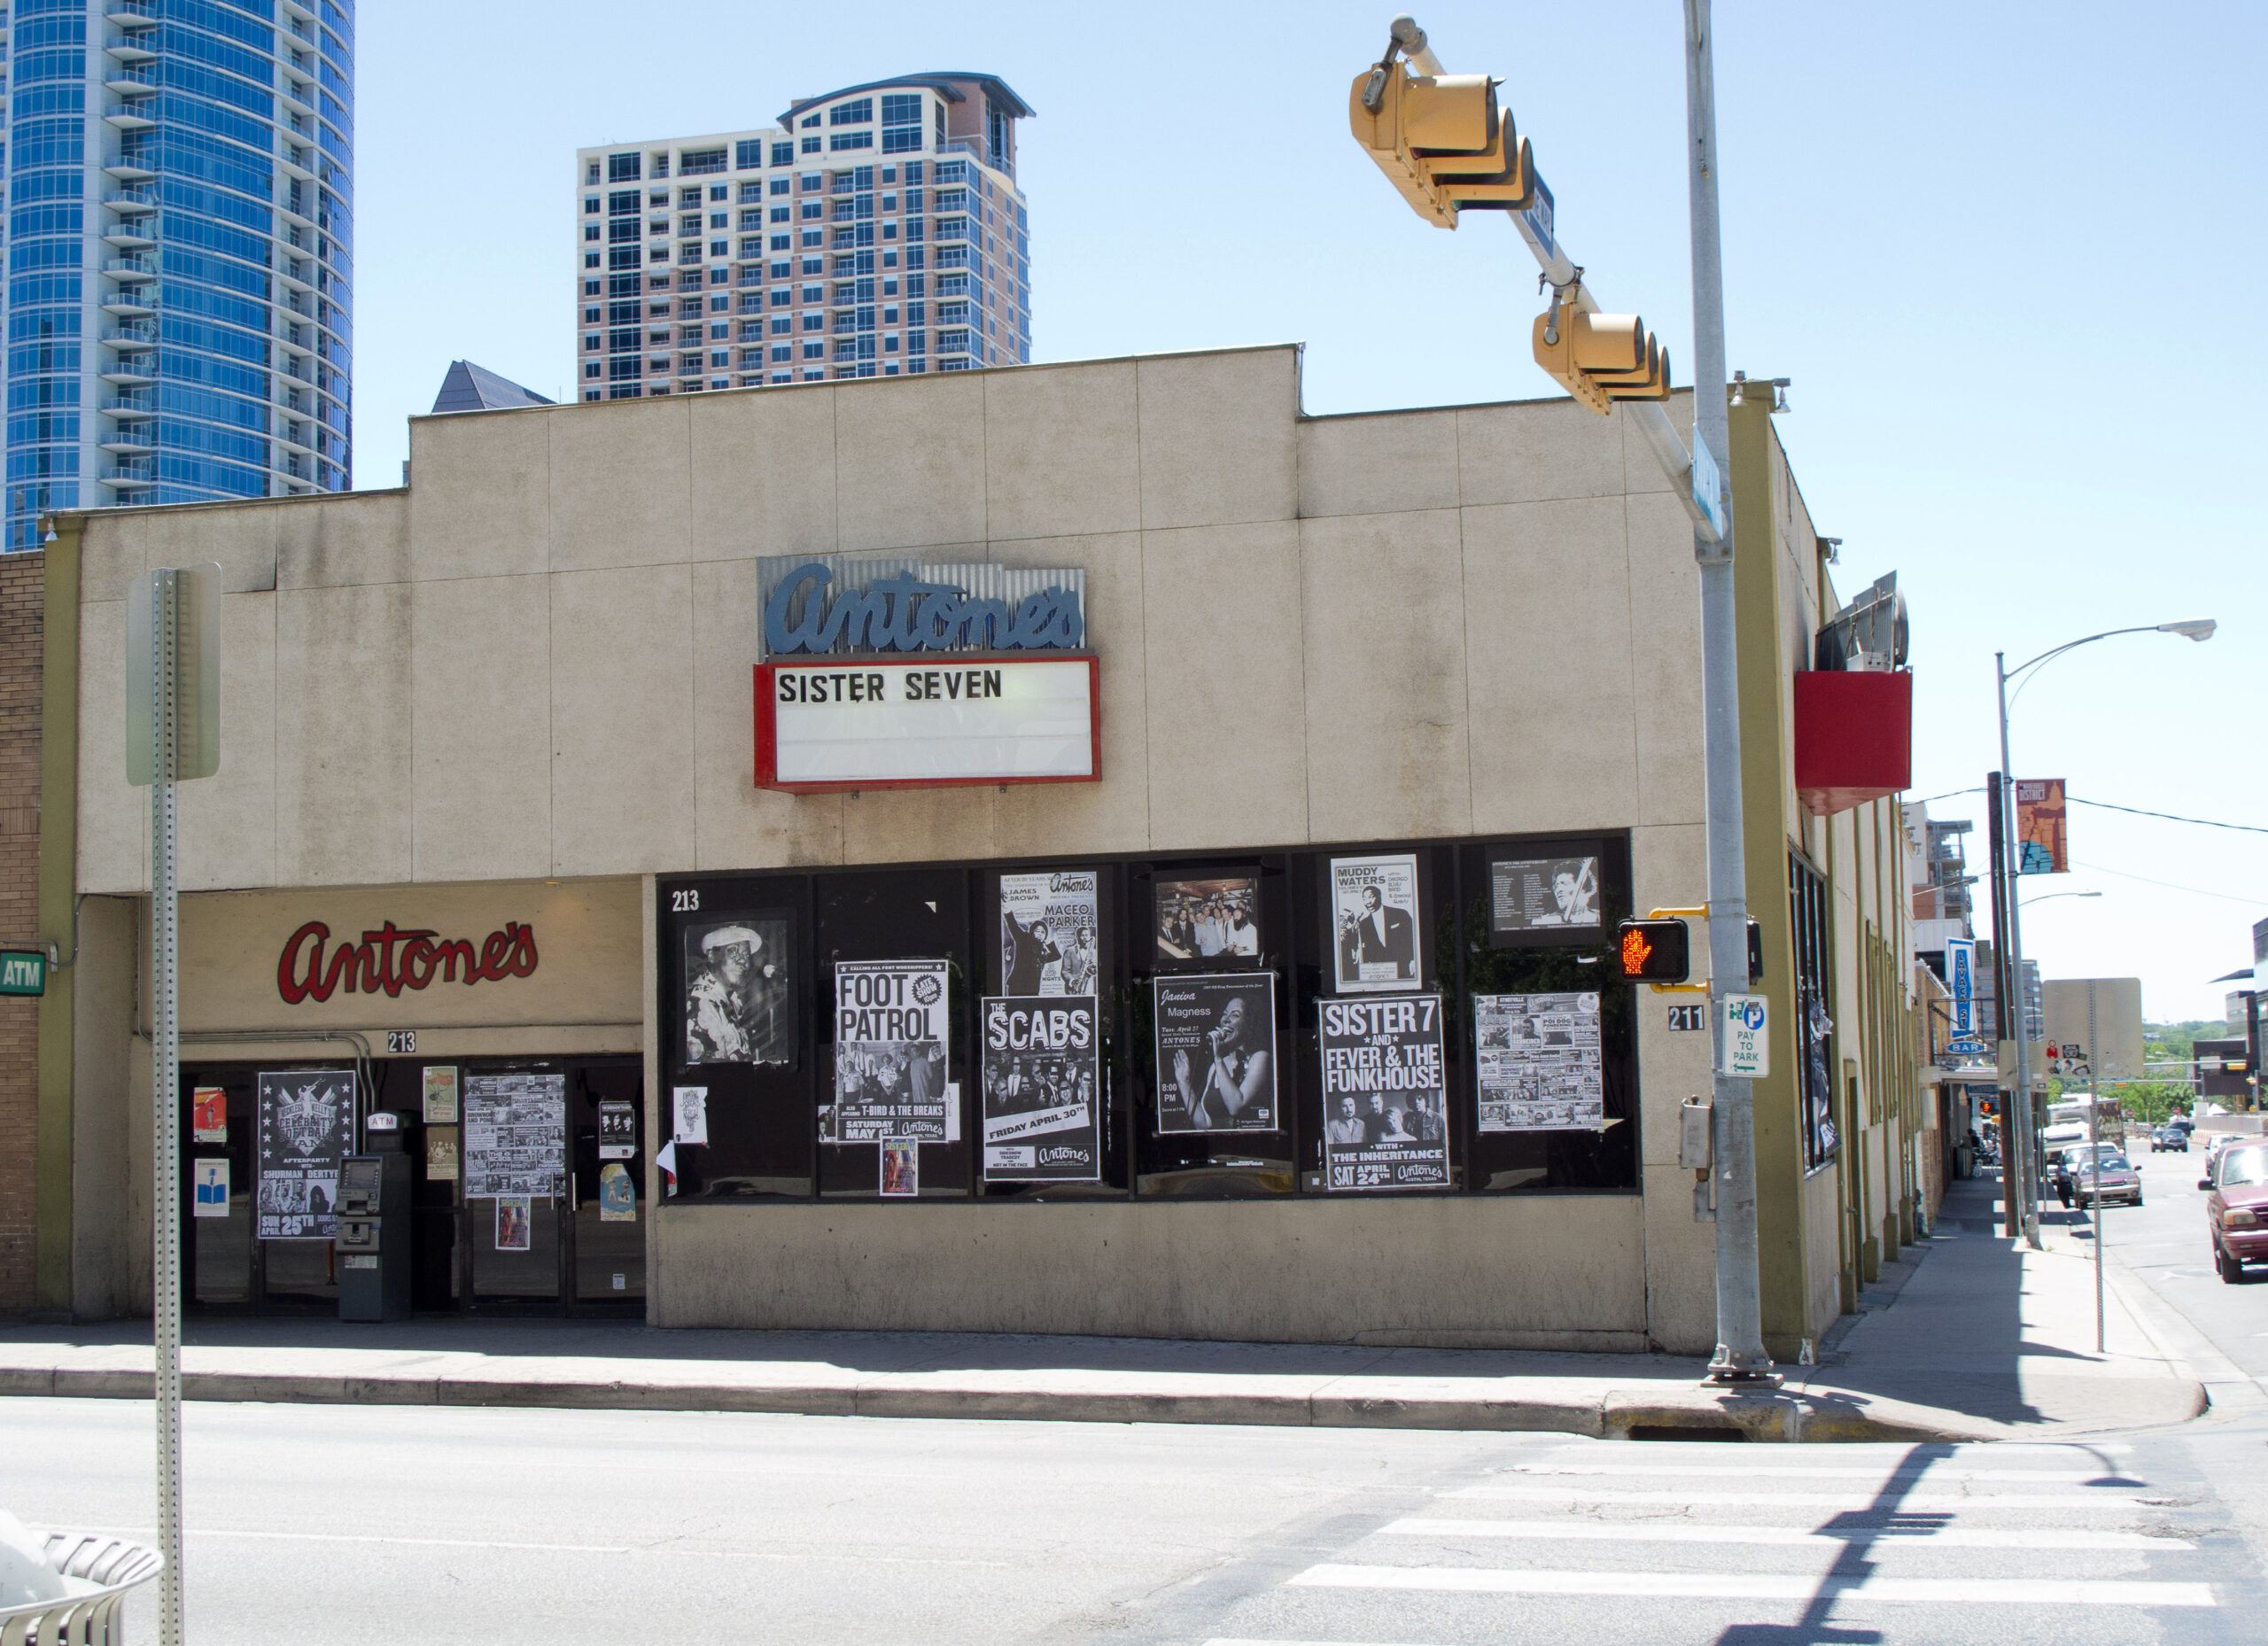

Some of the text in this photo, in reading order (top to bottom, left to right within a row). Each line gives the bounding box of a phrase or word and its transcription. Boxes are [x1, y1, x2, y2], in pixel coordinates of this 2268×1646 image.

[779, 670, 1001, 703] SISTER SEVEN
[2019, 789, 2045, 801] DISTRICT
[1338, 867, 1378, 876] MUDDY
[1050, 873, 1093, 893] Antone's
[1339, 876, 1386, 886] WATERS
[672, 890, 699, 912] 213
[1045, 905, 1089, 915] MACEO
[1049, 916, 1095, 927] PARKER
[3, 960, 39, 986] ATM
[1958, 952, 1967, 1003] LAVACA
[841, 974, 908, 1006] FOOT
[915, 977, 932, 990] LATE
[917, 984, 936, 999] SHOW
[1161, 989, 1195, 1005] Janiva
[990, 1003, 1006, 1013] THE
[1168, 1007, 1211, 1019] Magness
[841, 1008, 937, 1041] PATROL
[1325, 1000, 1436, 1037] SISTER 7
[1669, 1006, 1703, 1029] 211
[989, 1010, 1091, 1051] SCABS
[1737, 1031, 1755, 1040] PAY
[389, 1032, 416, 1052] 213
[1371, 1035, 1392, 1046] AND
[1326, 1044, 1440, 1069] FEVER & THE
[1734, 1052, 1758, 1061] PARK
[1327, 1066, 1441, 1092] FUNKHOUSE
[862, 1106, 943, 1116] T-BIRD & THE BREAKS
[280, 1117, 333, 1129] CELEBRITY
[371, 1116, 393, 1126] ATM
[989, 1106, 1084, 1139] FRIDAY APRIL 30TH
[846, 1129, 875, 1139] MAY
[1038, 1146, 1090, 1163] Antone's
[1332, 1149, 1443, 1162] THE INHERITANCE
[264, 1170, 303, 1179] SHURMAN
[1334, 1167, 1355, 1185] SAT
[1357, 1172, 1390, 1185] 24TH
[1398, 1164, 1442, 1180] Antone's
[261, 1216, 280, 1227] SUN
[282, 1215, 314, 1235] 25TH
